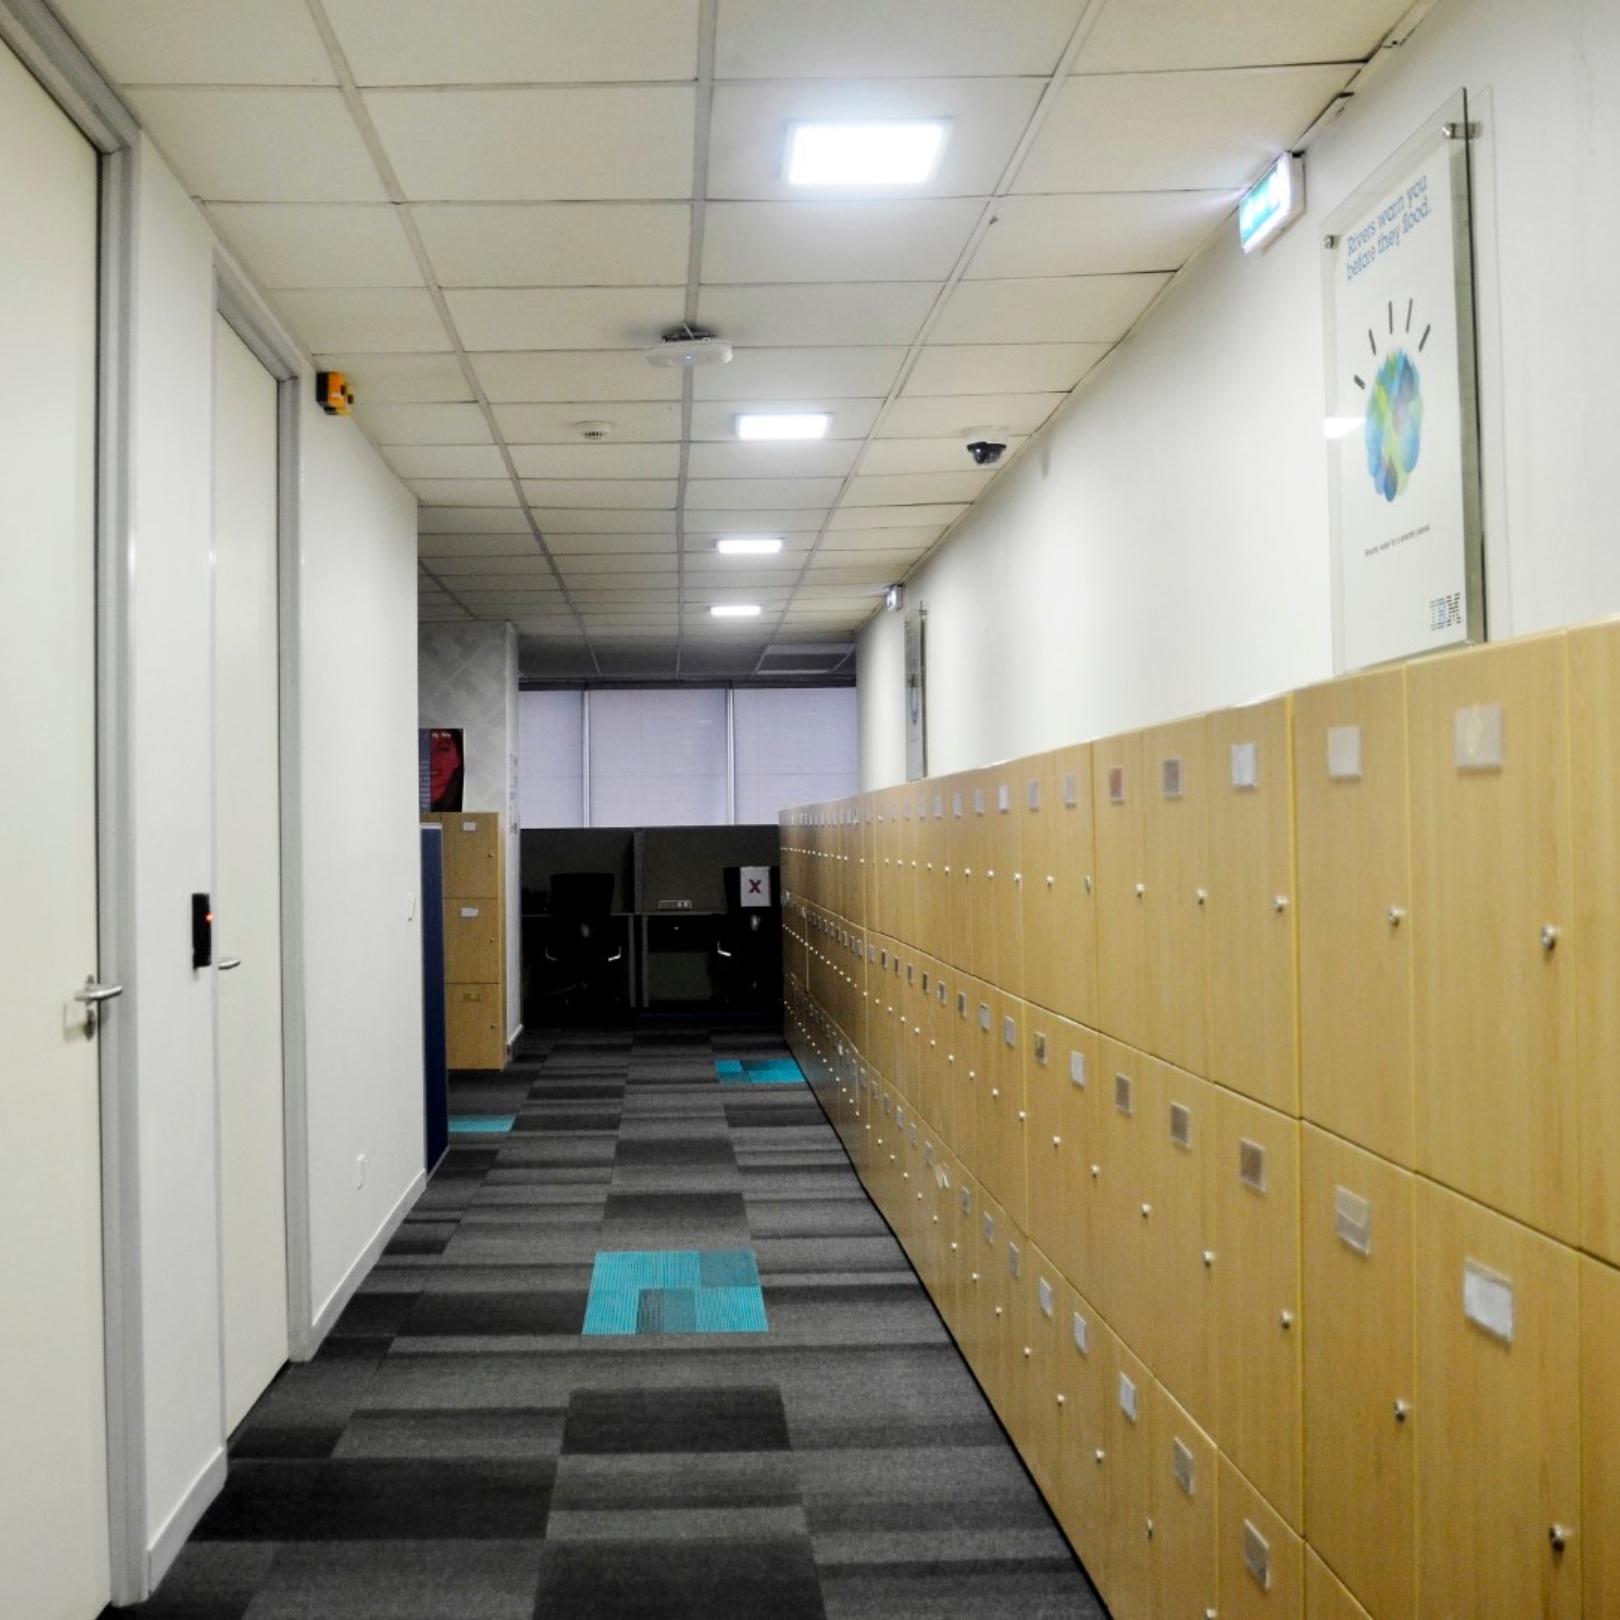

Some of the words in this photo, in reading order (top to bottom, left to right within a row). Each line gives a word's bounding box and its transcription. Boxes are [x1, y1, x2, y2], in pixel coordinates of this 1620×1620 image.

[1347, 220, 1376, 256] Rivers
[1378, 195, 1404, 228] warn
[1407, 174, 1427, 209] you
[1346, 245, 1376, 280] before
[1378, 223, 1400, 254] they
[1429, 592, 1461, 631] IBM
